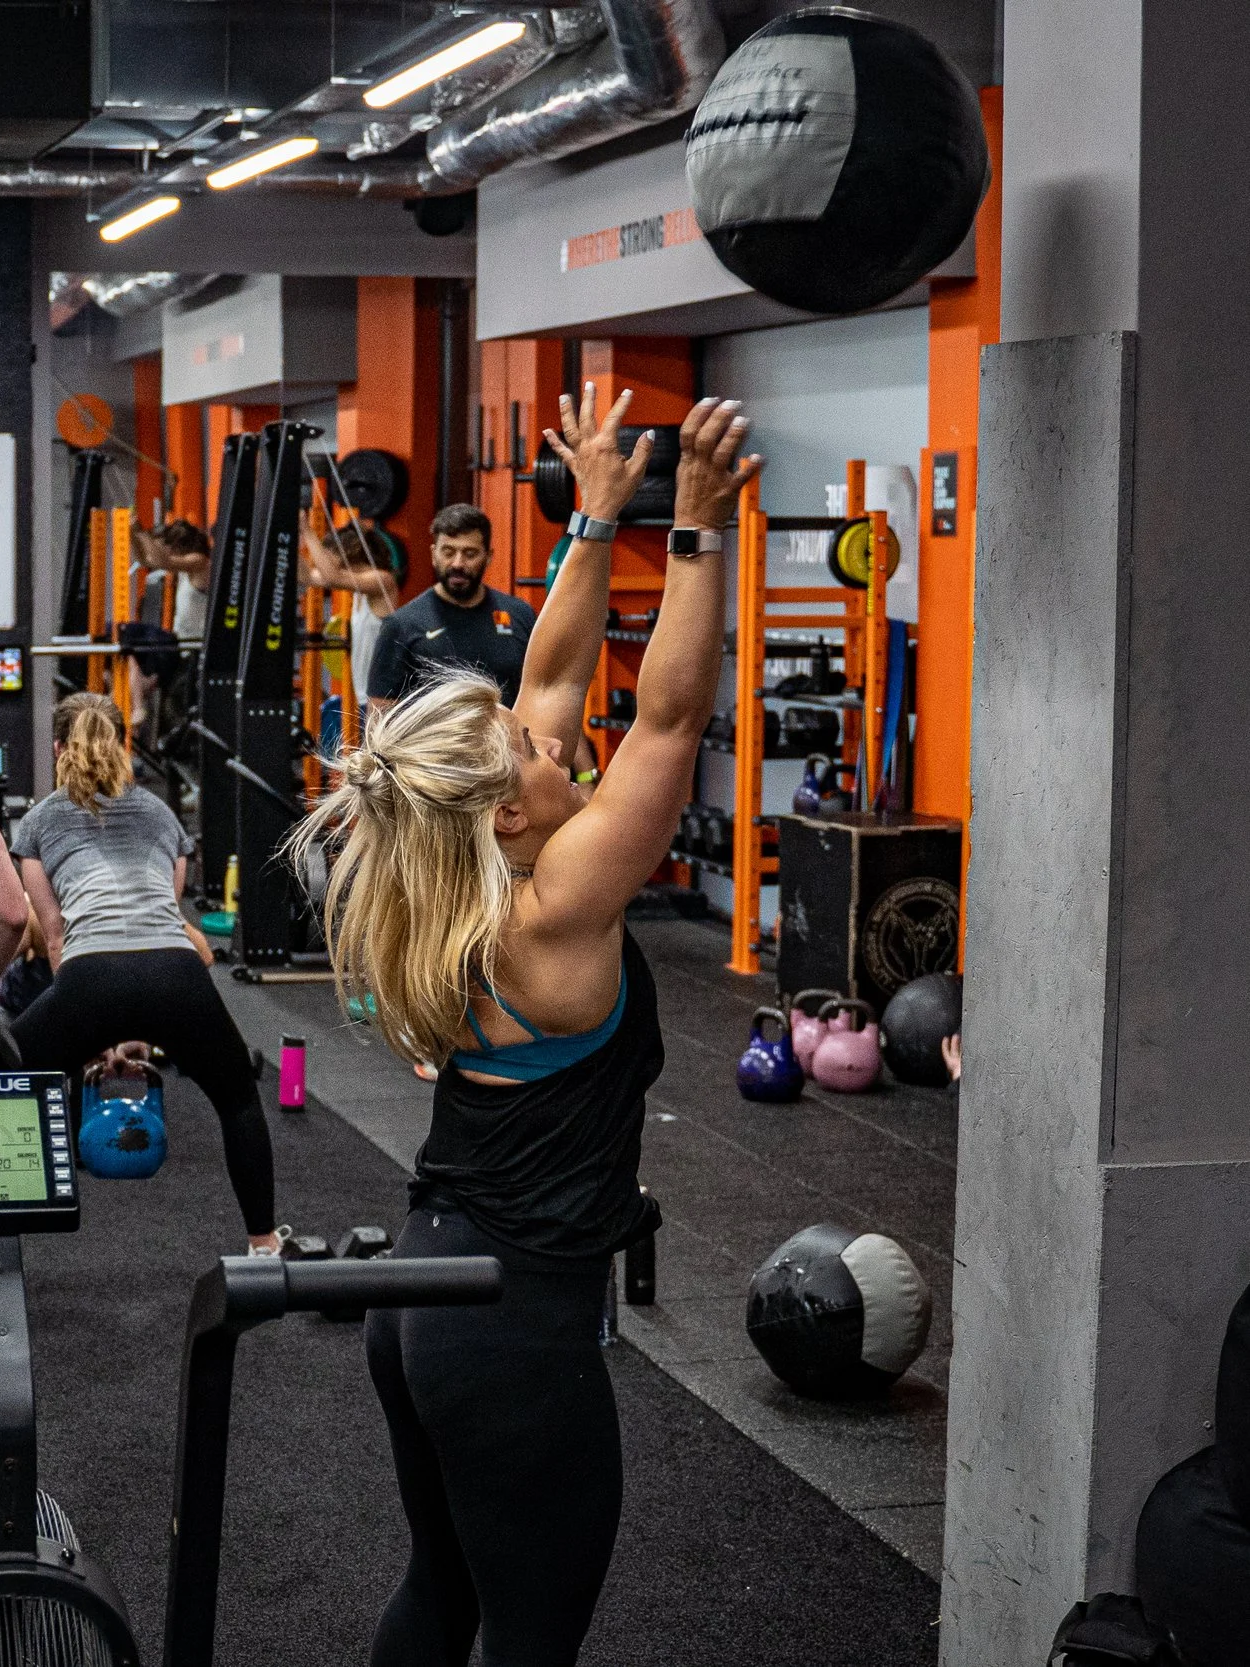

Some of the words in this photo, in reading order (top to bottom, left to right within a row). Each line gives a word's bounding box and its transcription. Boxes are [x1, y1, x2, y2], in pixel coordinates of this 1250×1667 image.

[277, 531, 291, 544] 2
[270, 546, 289, 625] concept
[23, 1131, 31, 1143] 0
[28, 1158, 40, 1169] 14
